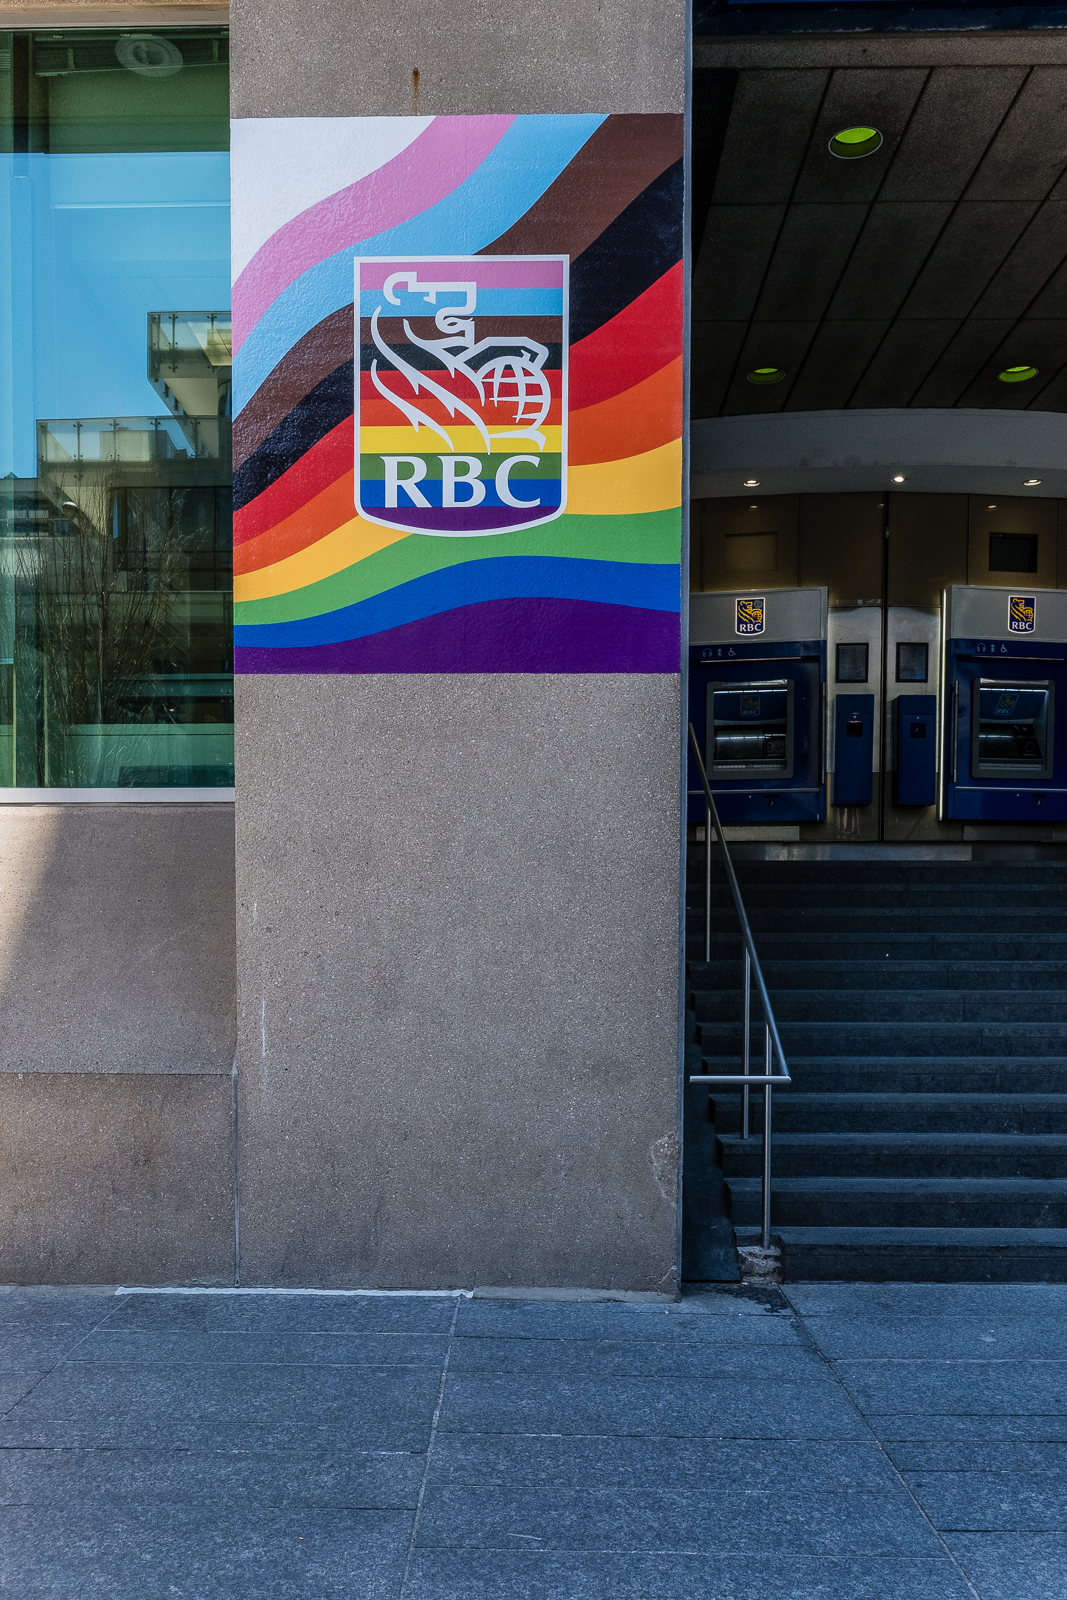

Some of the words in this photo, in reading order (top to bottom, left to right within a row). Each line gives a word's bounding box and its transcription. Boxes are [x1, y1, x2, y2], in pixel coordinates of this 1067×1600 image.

[379, 454, 541, 508] RBC
[739, 623, 762, 632] RBC
[1011, 621, 1032, 630] RBC
